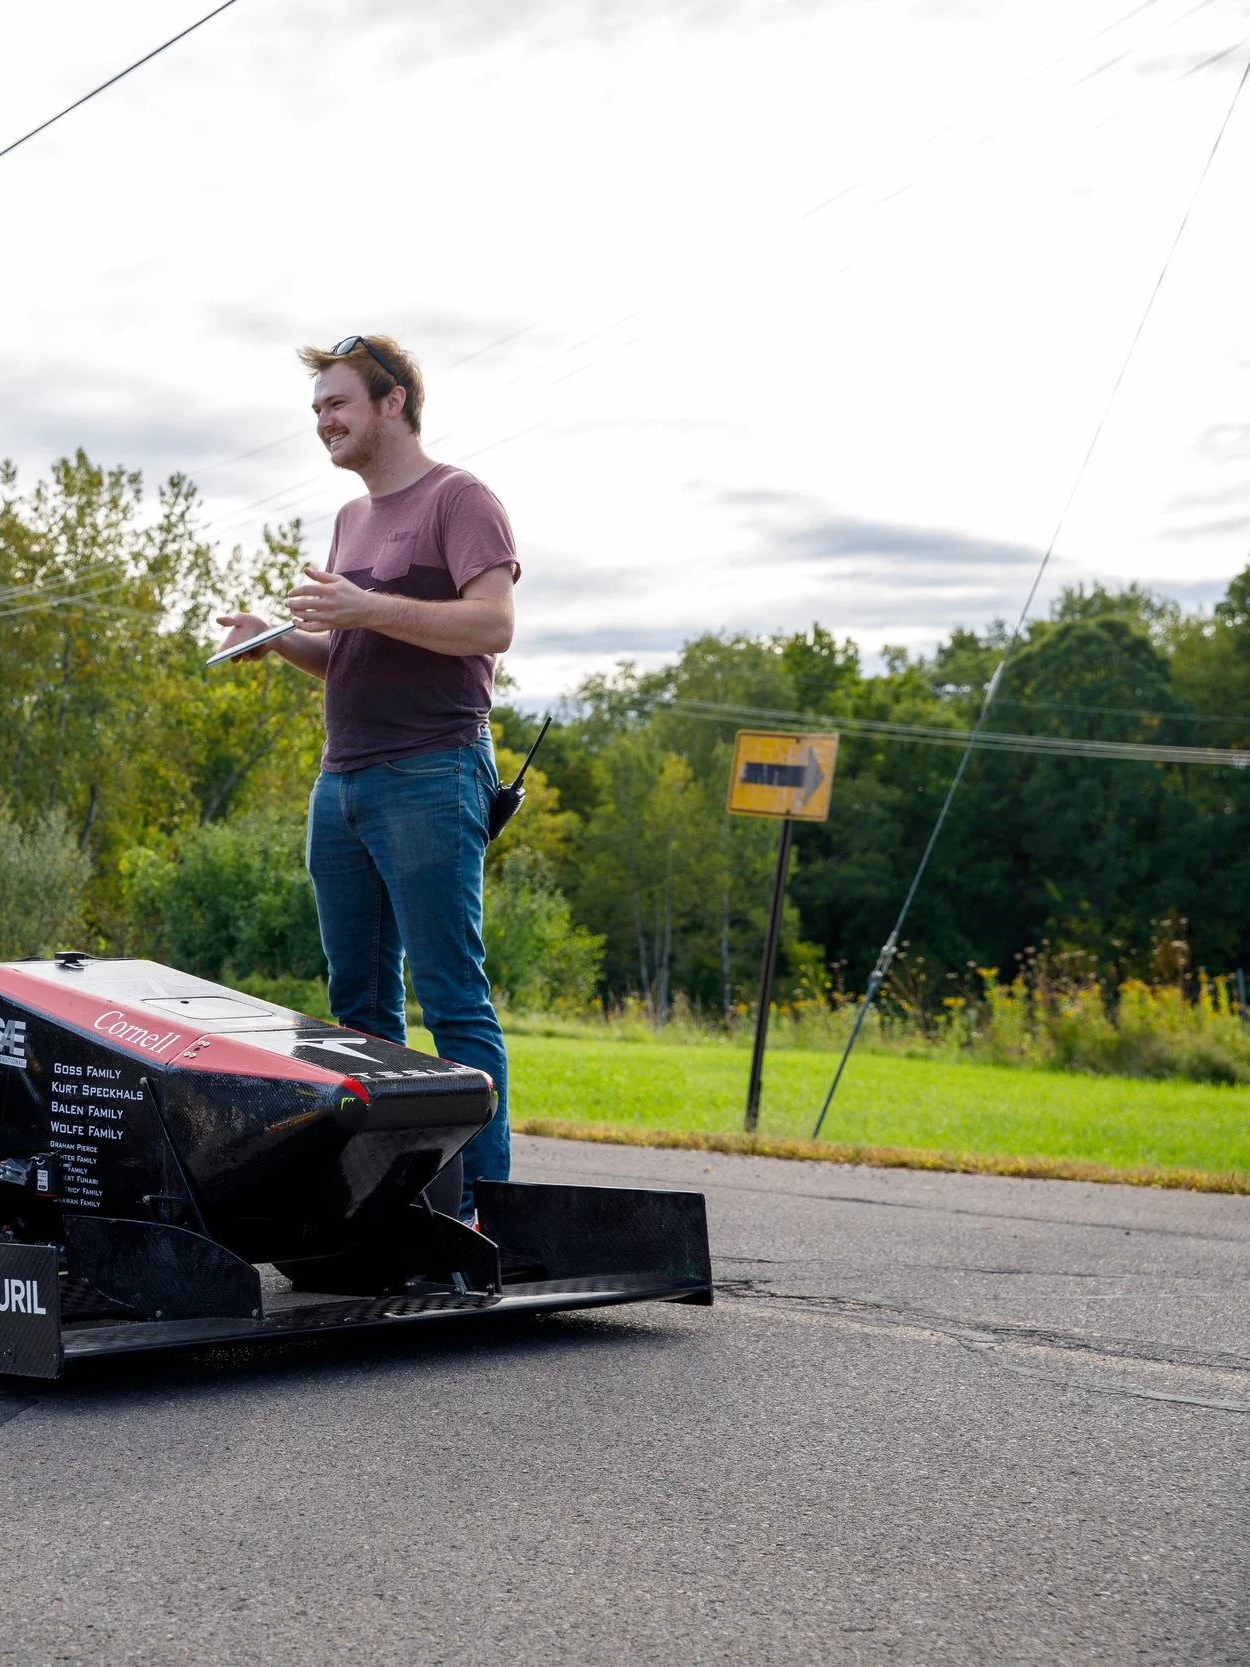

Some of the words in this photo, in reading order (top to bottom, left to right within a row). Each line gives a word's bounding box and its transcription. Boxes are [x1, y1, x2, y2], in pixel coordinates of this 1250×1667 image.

[93, 1010, 182, 1054] Cornell
[54, 1063, 82, 1076] GOSS
[86, 1066, 121, 1079] FAMILY
[51, 1081, 78, 1095] KURT
[82, 1084, 144, 1101] SPECKHALS
[51, 1101, 84, 1115] BALEN
[88, 1105, 124, 1119] FAMILY
[50, 1121, 85, 1136] WOLFE
[88, 1126, 124, 1140] FAMILY
